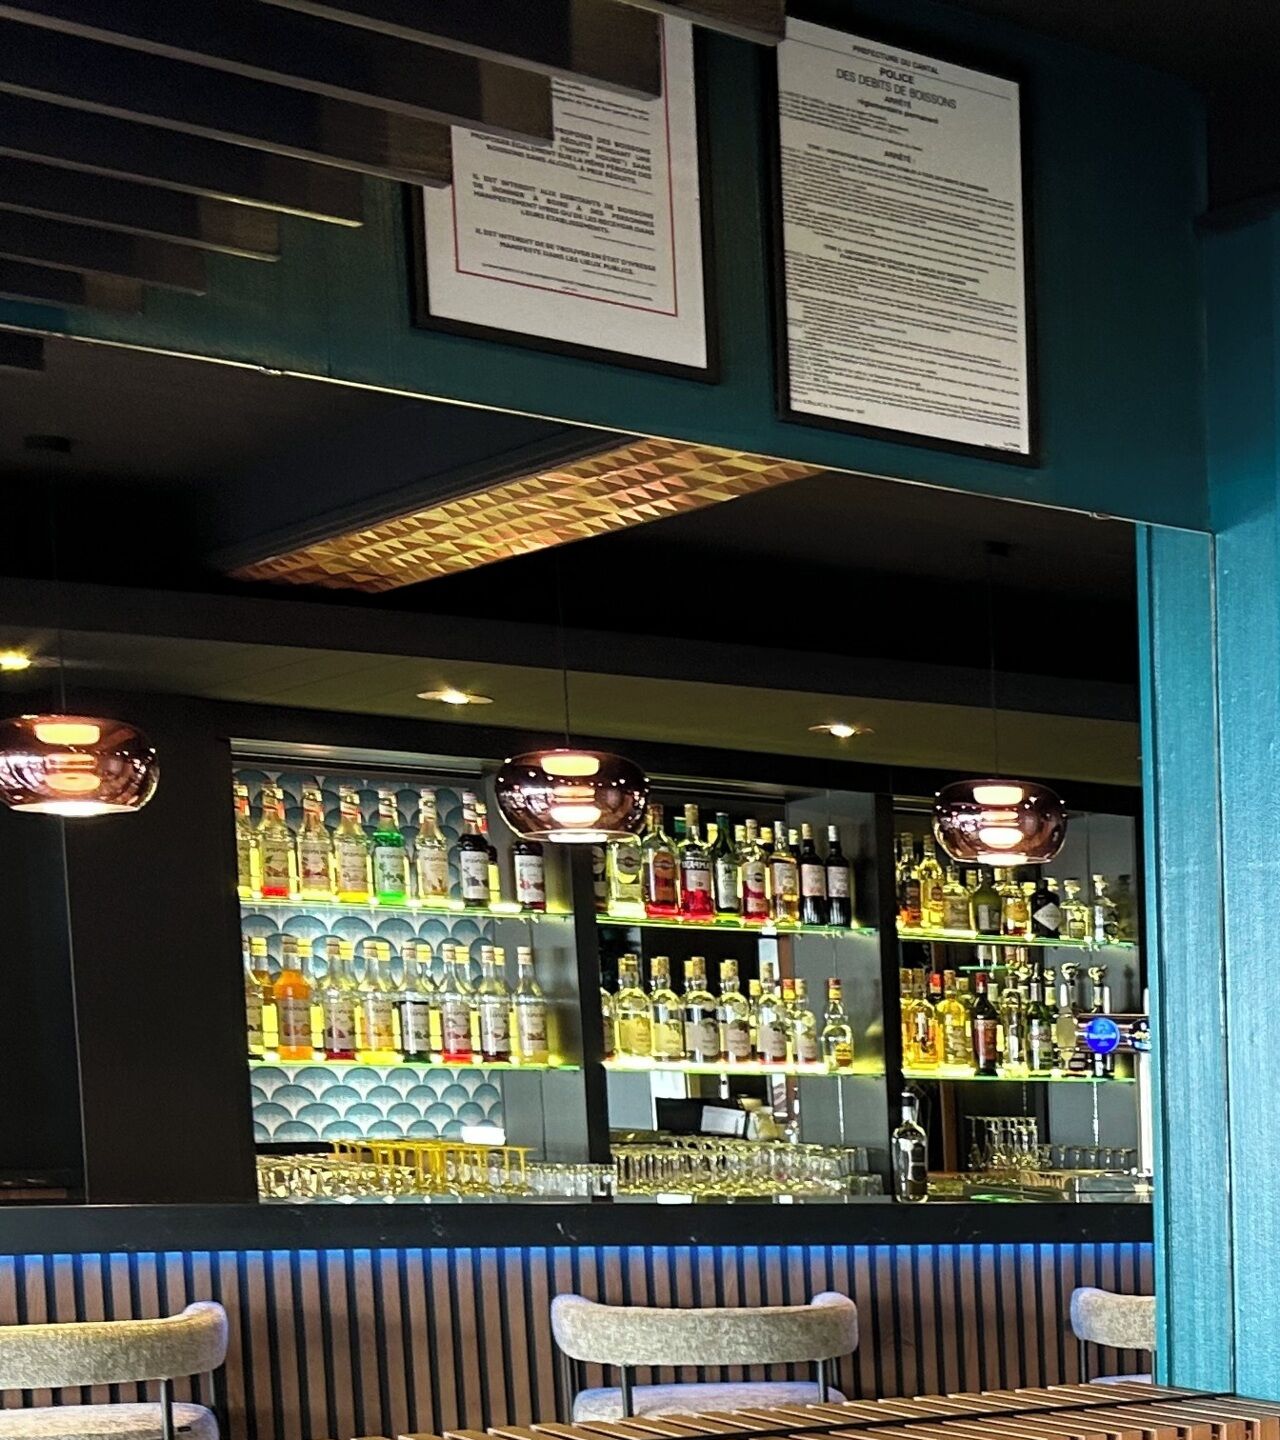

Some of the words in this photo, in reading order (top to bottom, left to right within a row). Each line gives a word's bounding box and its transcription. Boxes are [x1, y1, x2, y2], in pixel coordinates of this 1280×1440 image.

[836, 69, 856, 82] DES
[894, 83, 907, 96] DE
[909, 87, 957, 110] BOISSONS
[879, 67, 914, 84] POLICE
